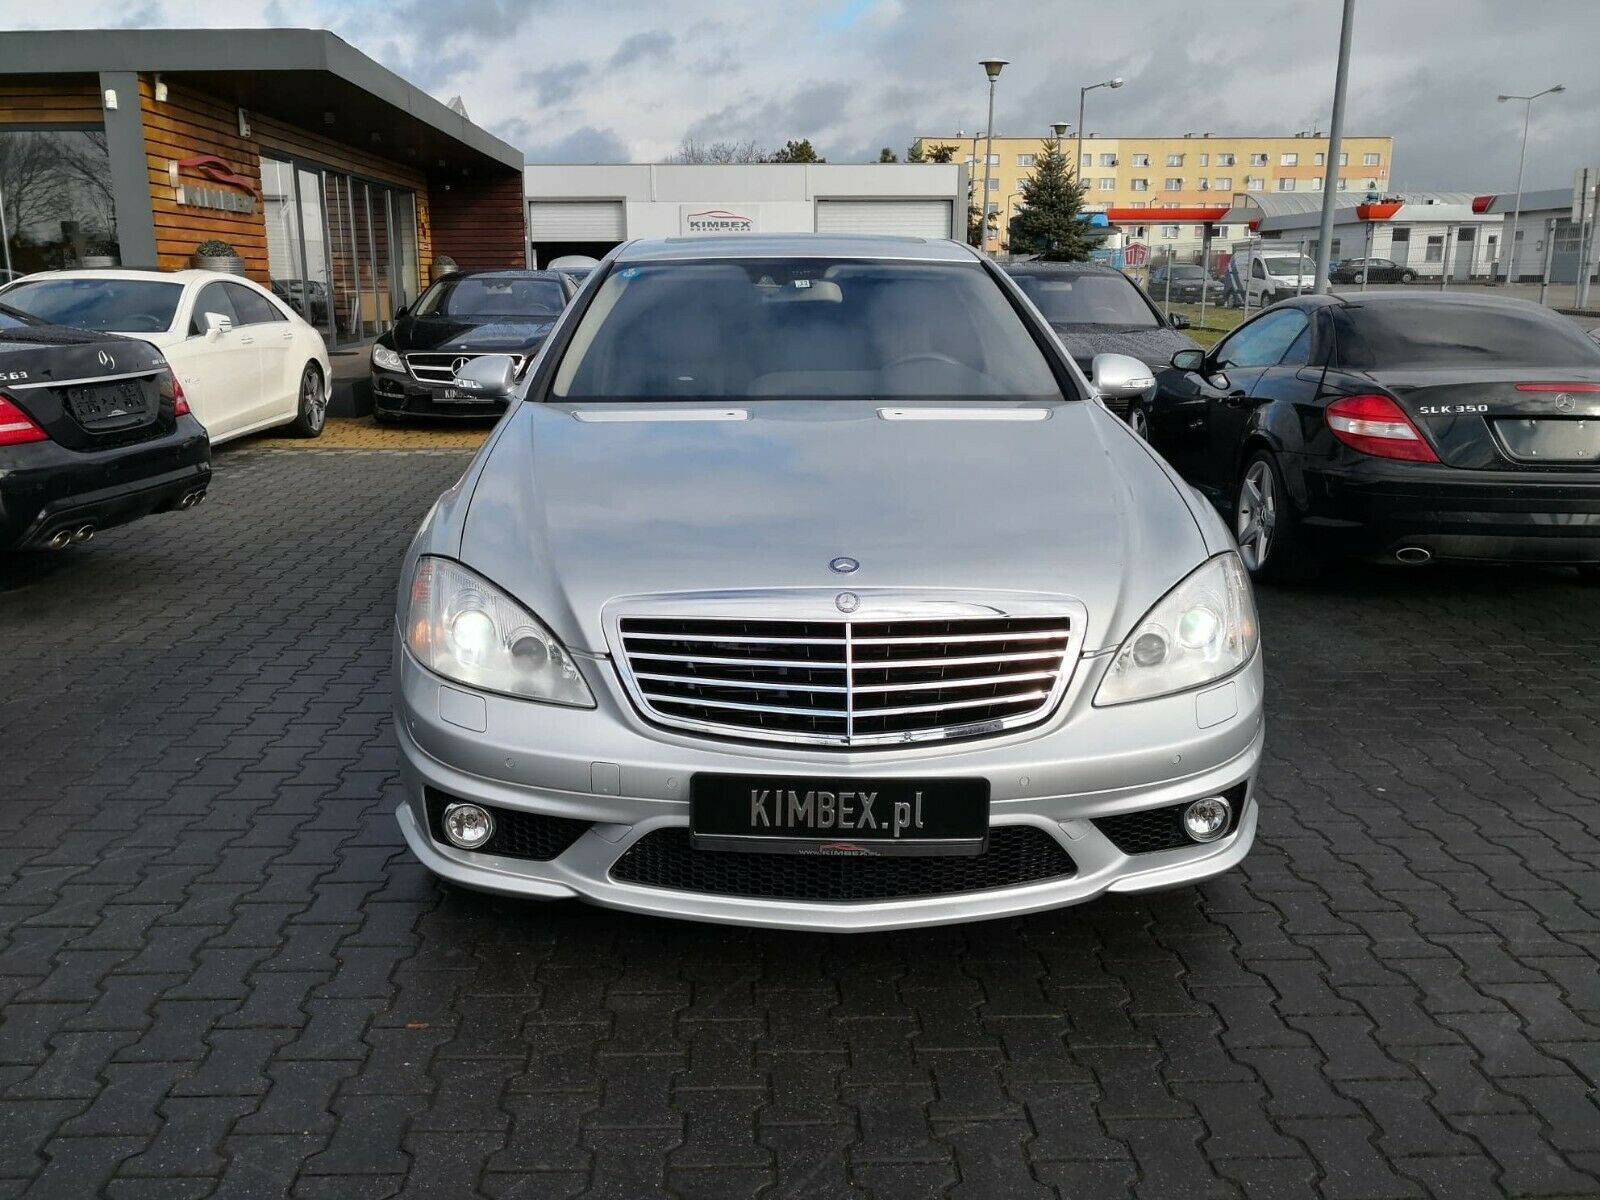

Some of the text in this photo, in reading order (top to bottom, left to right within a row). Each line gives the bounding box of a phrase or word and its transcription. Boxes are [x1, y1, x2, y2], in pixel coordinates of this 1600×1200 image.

[1420, 404, 1488, 414] SLK 350
[750, 789, 924, 838] KIMBEX.pl
